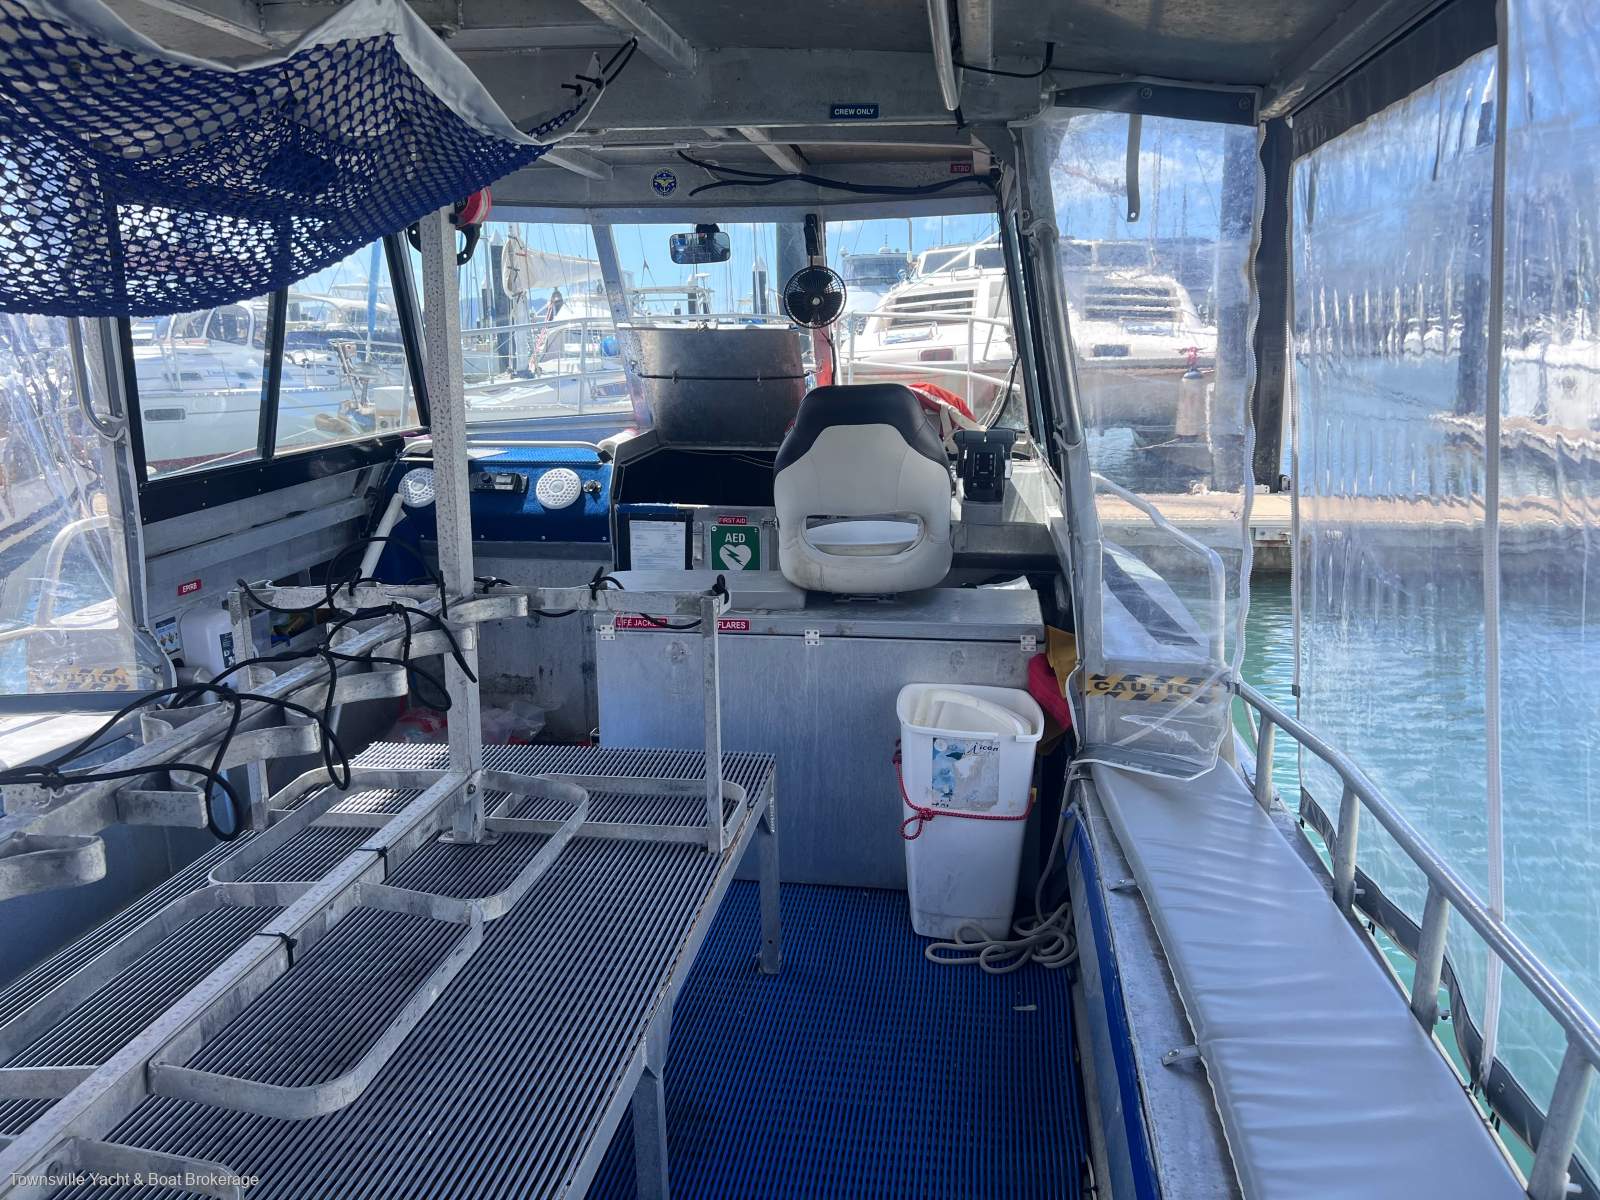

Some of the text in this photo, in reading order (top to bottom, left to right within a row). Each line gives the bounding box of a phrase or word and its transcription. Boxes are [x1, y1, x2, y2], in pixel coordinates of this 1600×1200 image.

[725, 532, 746, 543] AED
[617, 617, 632, 626] LIFE
[717, 621, 746, 629] FLARES
[1094, 681, 1205, 695] CAUTIO
